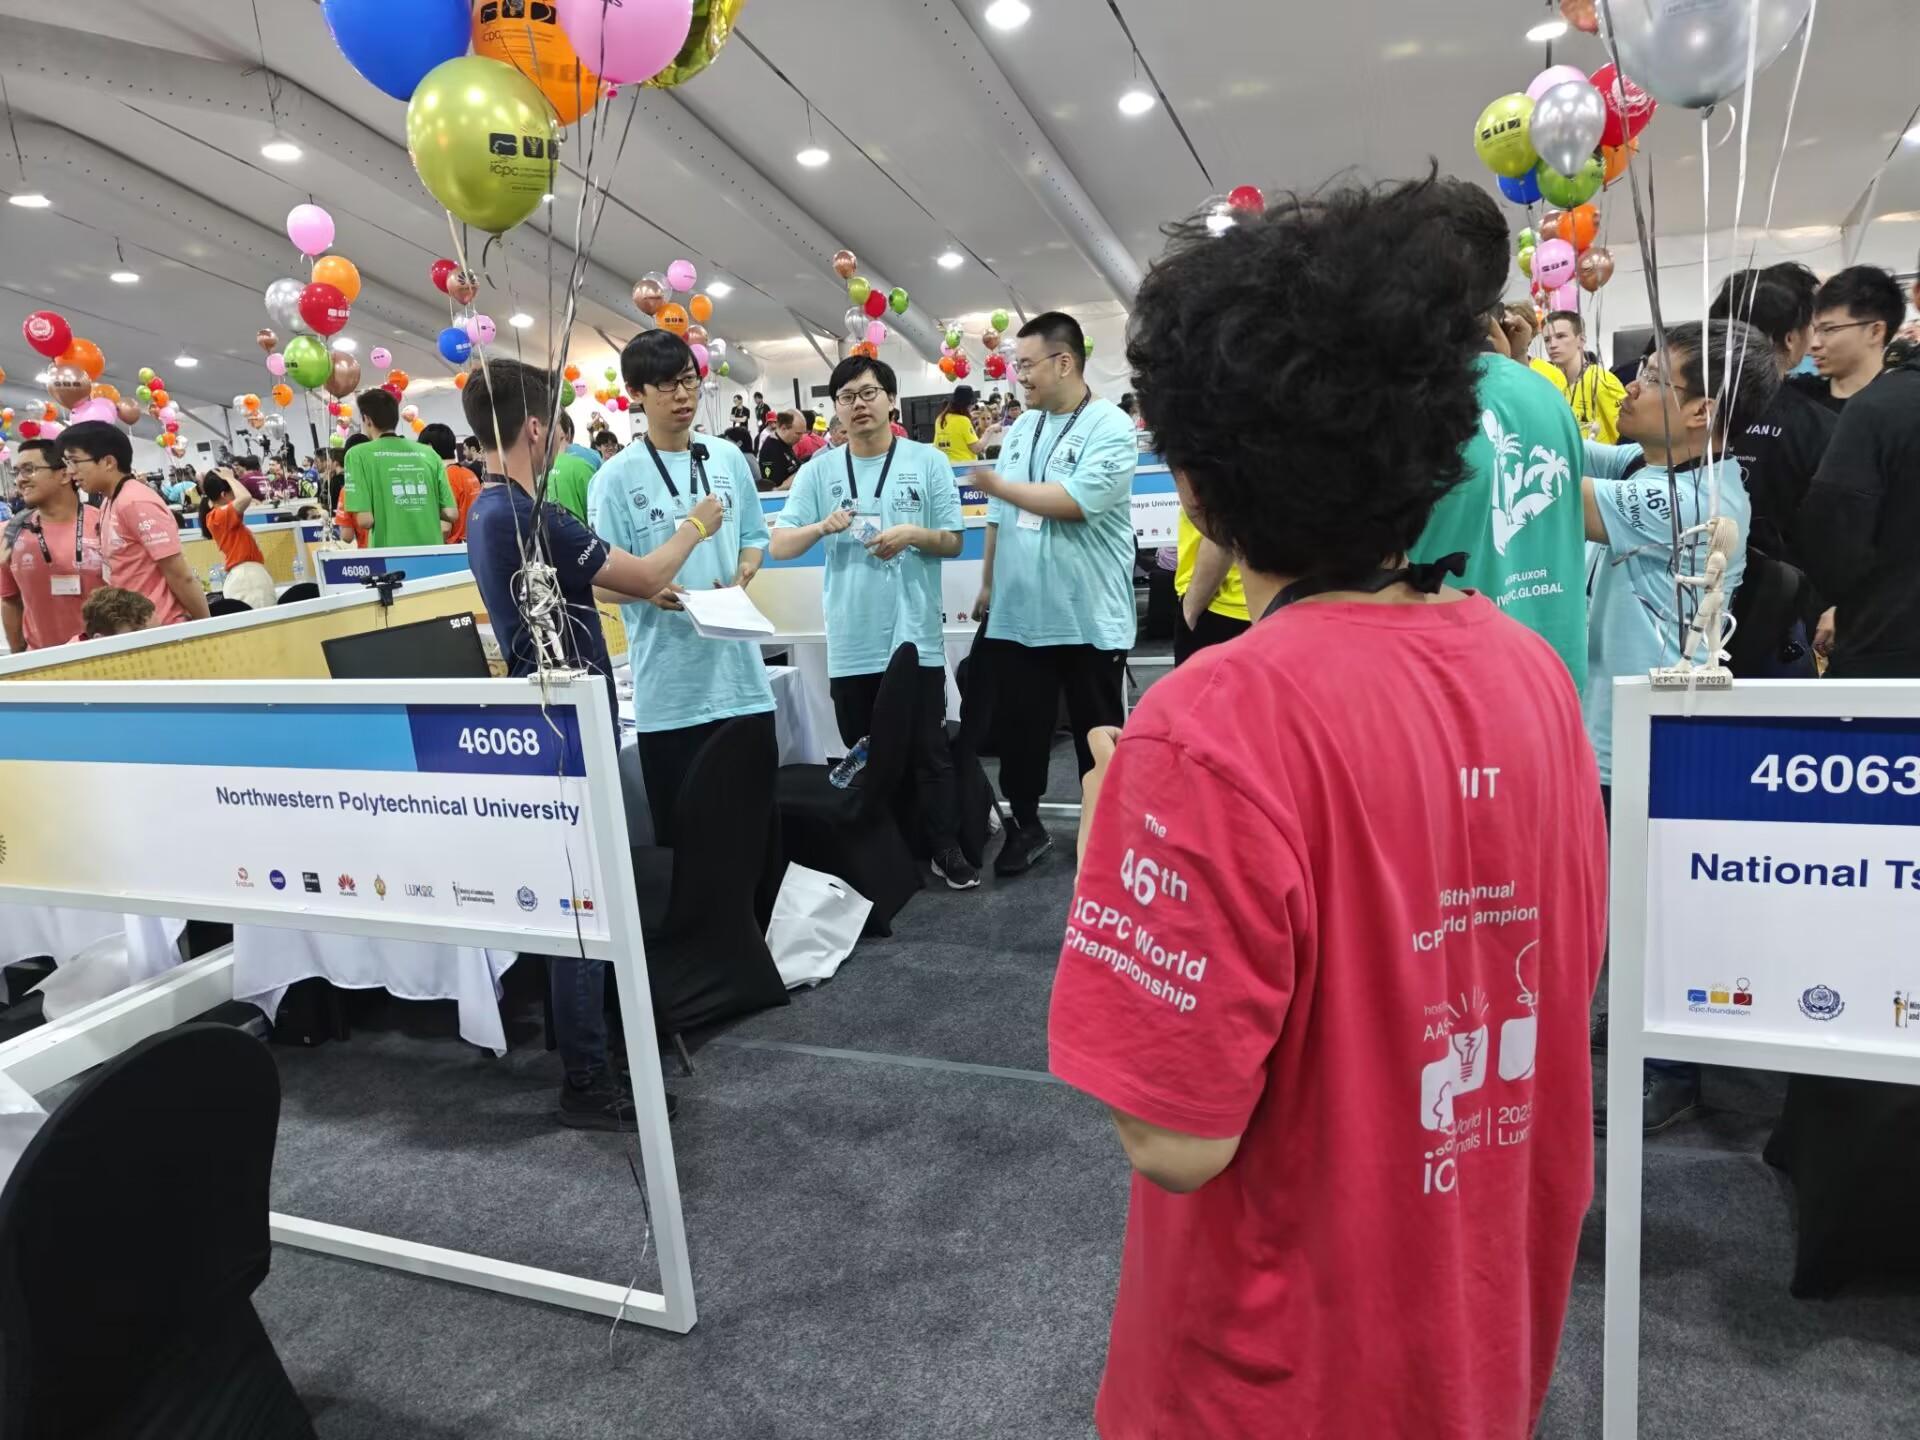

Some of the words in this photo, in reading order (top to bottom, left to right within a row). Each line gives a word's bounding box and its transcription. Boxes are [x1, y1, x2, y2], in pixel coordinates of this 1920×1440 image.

[1645, 488, 1672, 520] 46th
[342, 565, 370, 577] 46080
[458, 727, 541, 756] 46068
[1750, 754, 1920, 796] 46063
[216, 786, 335, 811] Northwestern
[338, 791, 468, 816] Polytechnical
[473, 797, 580, 826] University
[1144, 813, 1168, 838] The
[1119, 848, 1189, 906] 46th
[1690, 852, 1869, 888] National
[1073, 896, 1133, 940] ICPC
[1135, 924, 1208, 982] World
[1412, 929, 1444, 953] ICP
[1065, 925, 1197, 1013] Championship
[1423, 1151, 1456, 1195] ic
